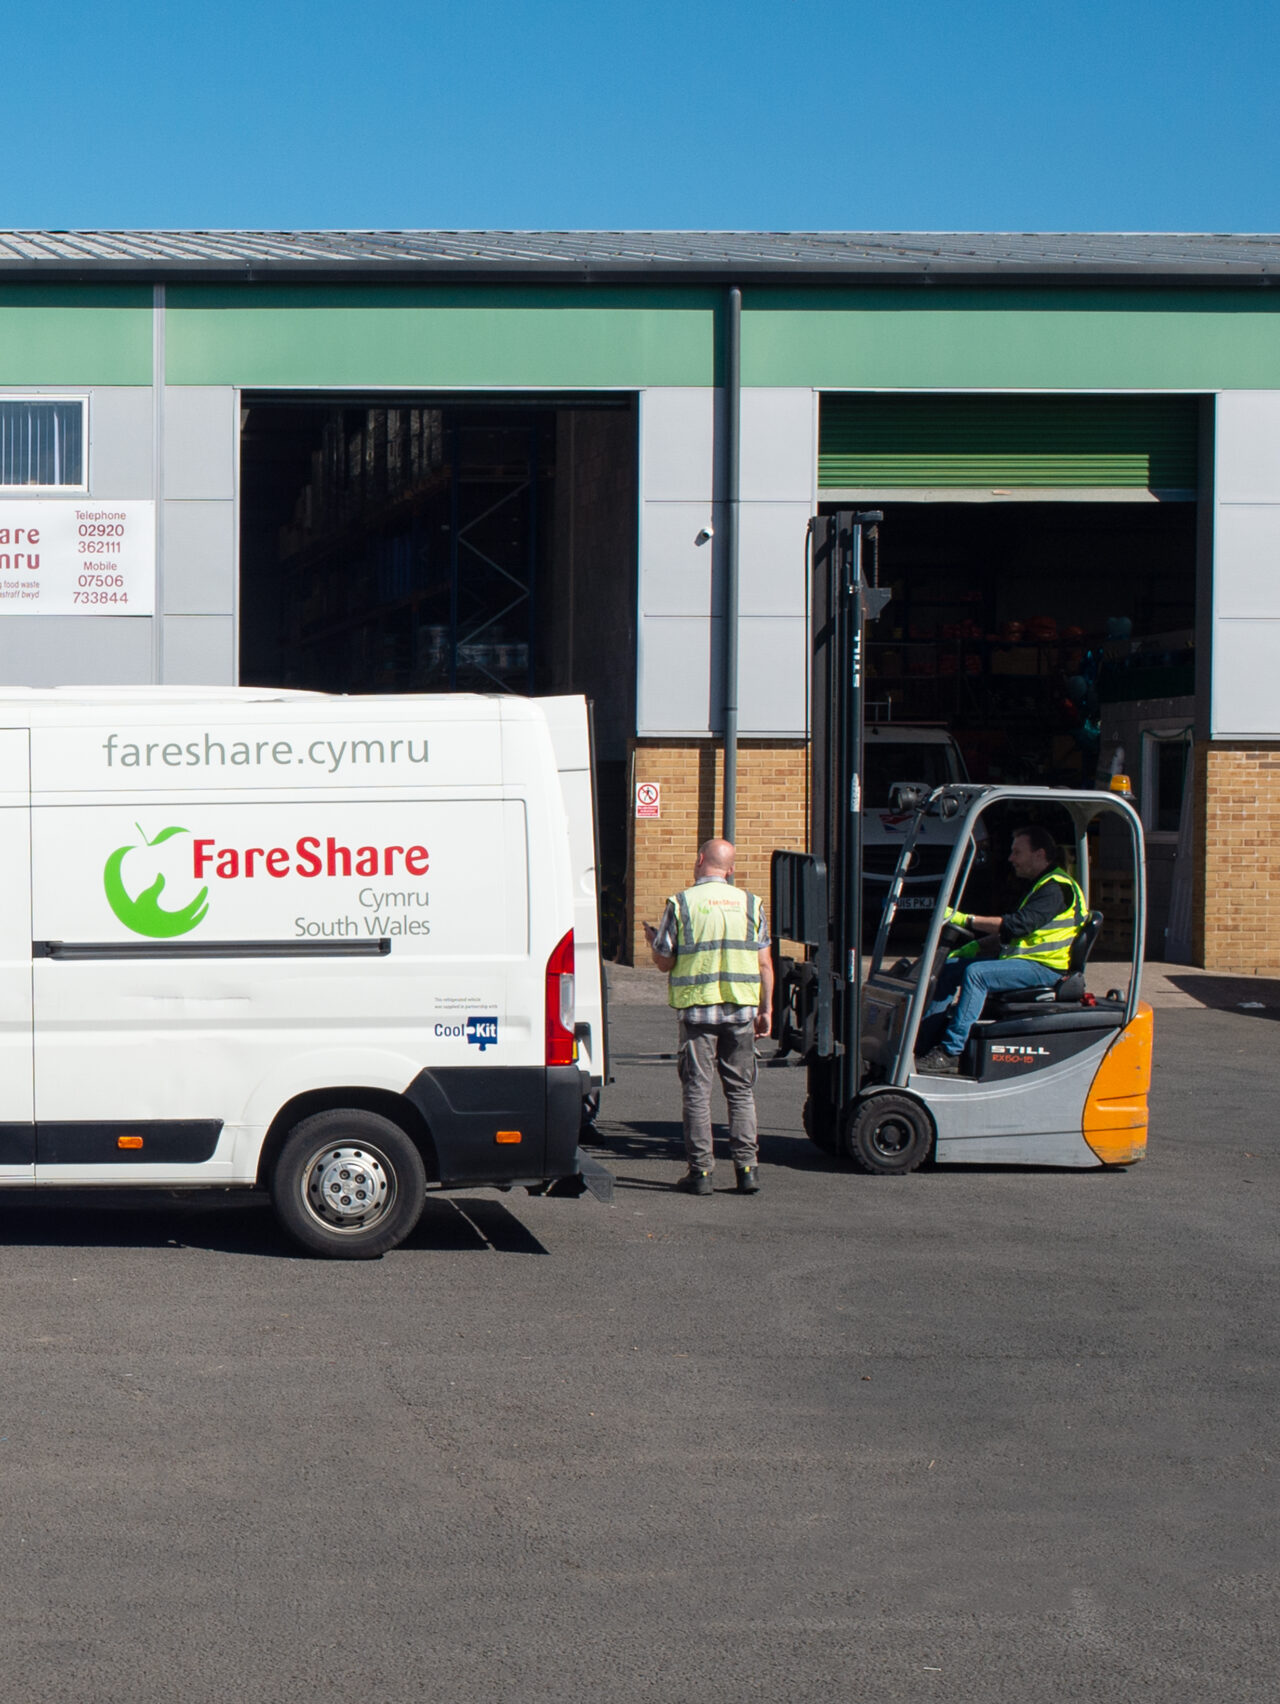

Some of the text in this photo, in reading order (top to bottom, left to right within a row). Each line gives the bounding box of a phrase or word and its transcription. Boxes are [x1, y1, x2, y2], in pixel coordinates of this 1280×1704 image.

[75, 510, 126, 521] Telephone
[78, 524, 125, 537] 02920
[77, 541, 121, 553] 362111
[83, 561, 117, 571] Mobile
[4, 580, 20, 589] food
[21, 580, 40, 589] waste
[78, 575, 124, 587] 07506
[21, 590, 40, 600] bwyd
[73, 591, 128, 604] 733844
[102, 733, 430, 773] fareshare.cymru
[193, 836, 429, 879] FareShare
[358, 887, 429, 912] Cymru
[294, 915, 431, 937] South Wales
[434, 1023, 497, 1038] Cool Kit
[991, 1045, 1050, 1055] STILL
